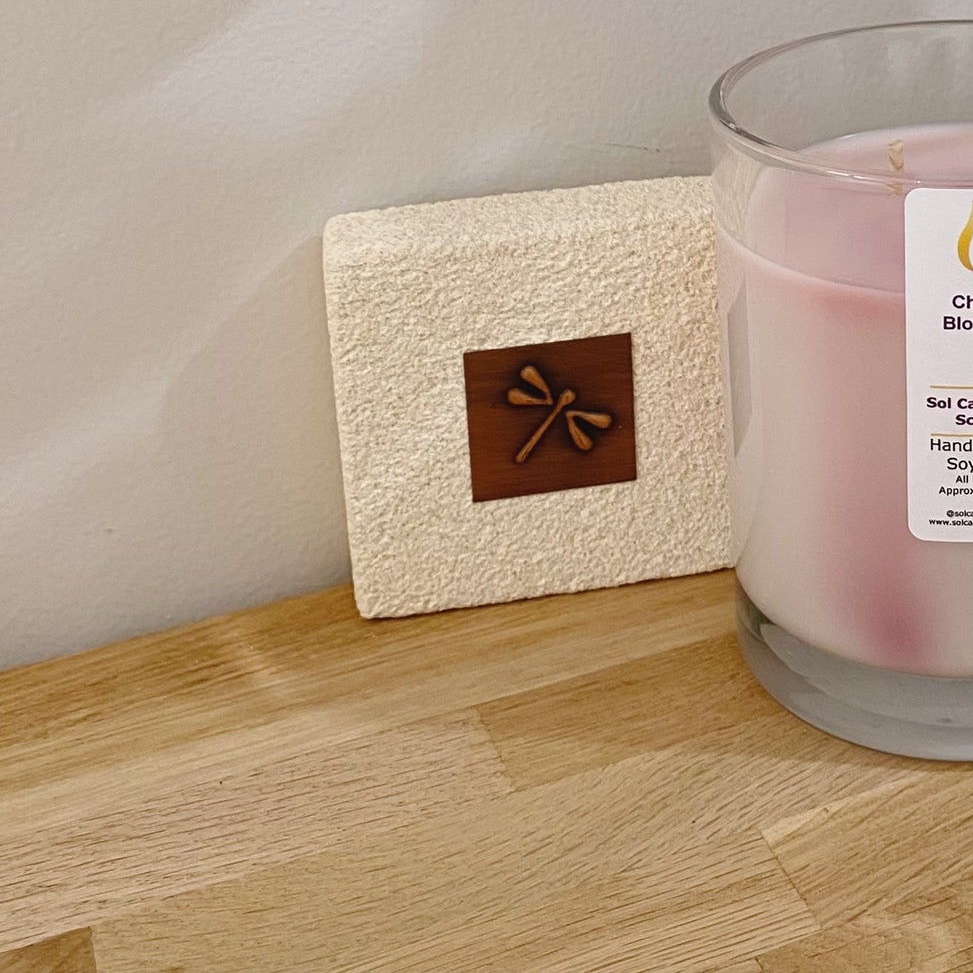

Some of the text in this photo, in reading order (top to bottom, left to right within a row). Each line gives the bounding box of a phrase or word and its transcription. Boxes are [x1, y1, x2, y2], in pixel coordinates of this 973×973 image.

[926, 397, 952, 409] Sol
[930, 438, 972, 452] Hand
[955, 475, 969, 484] All
